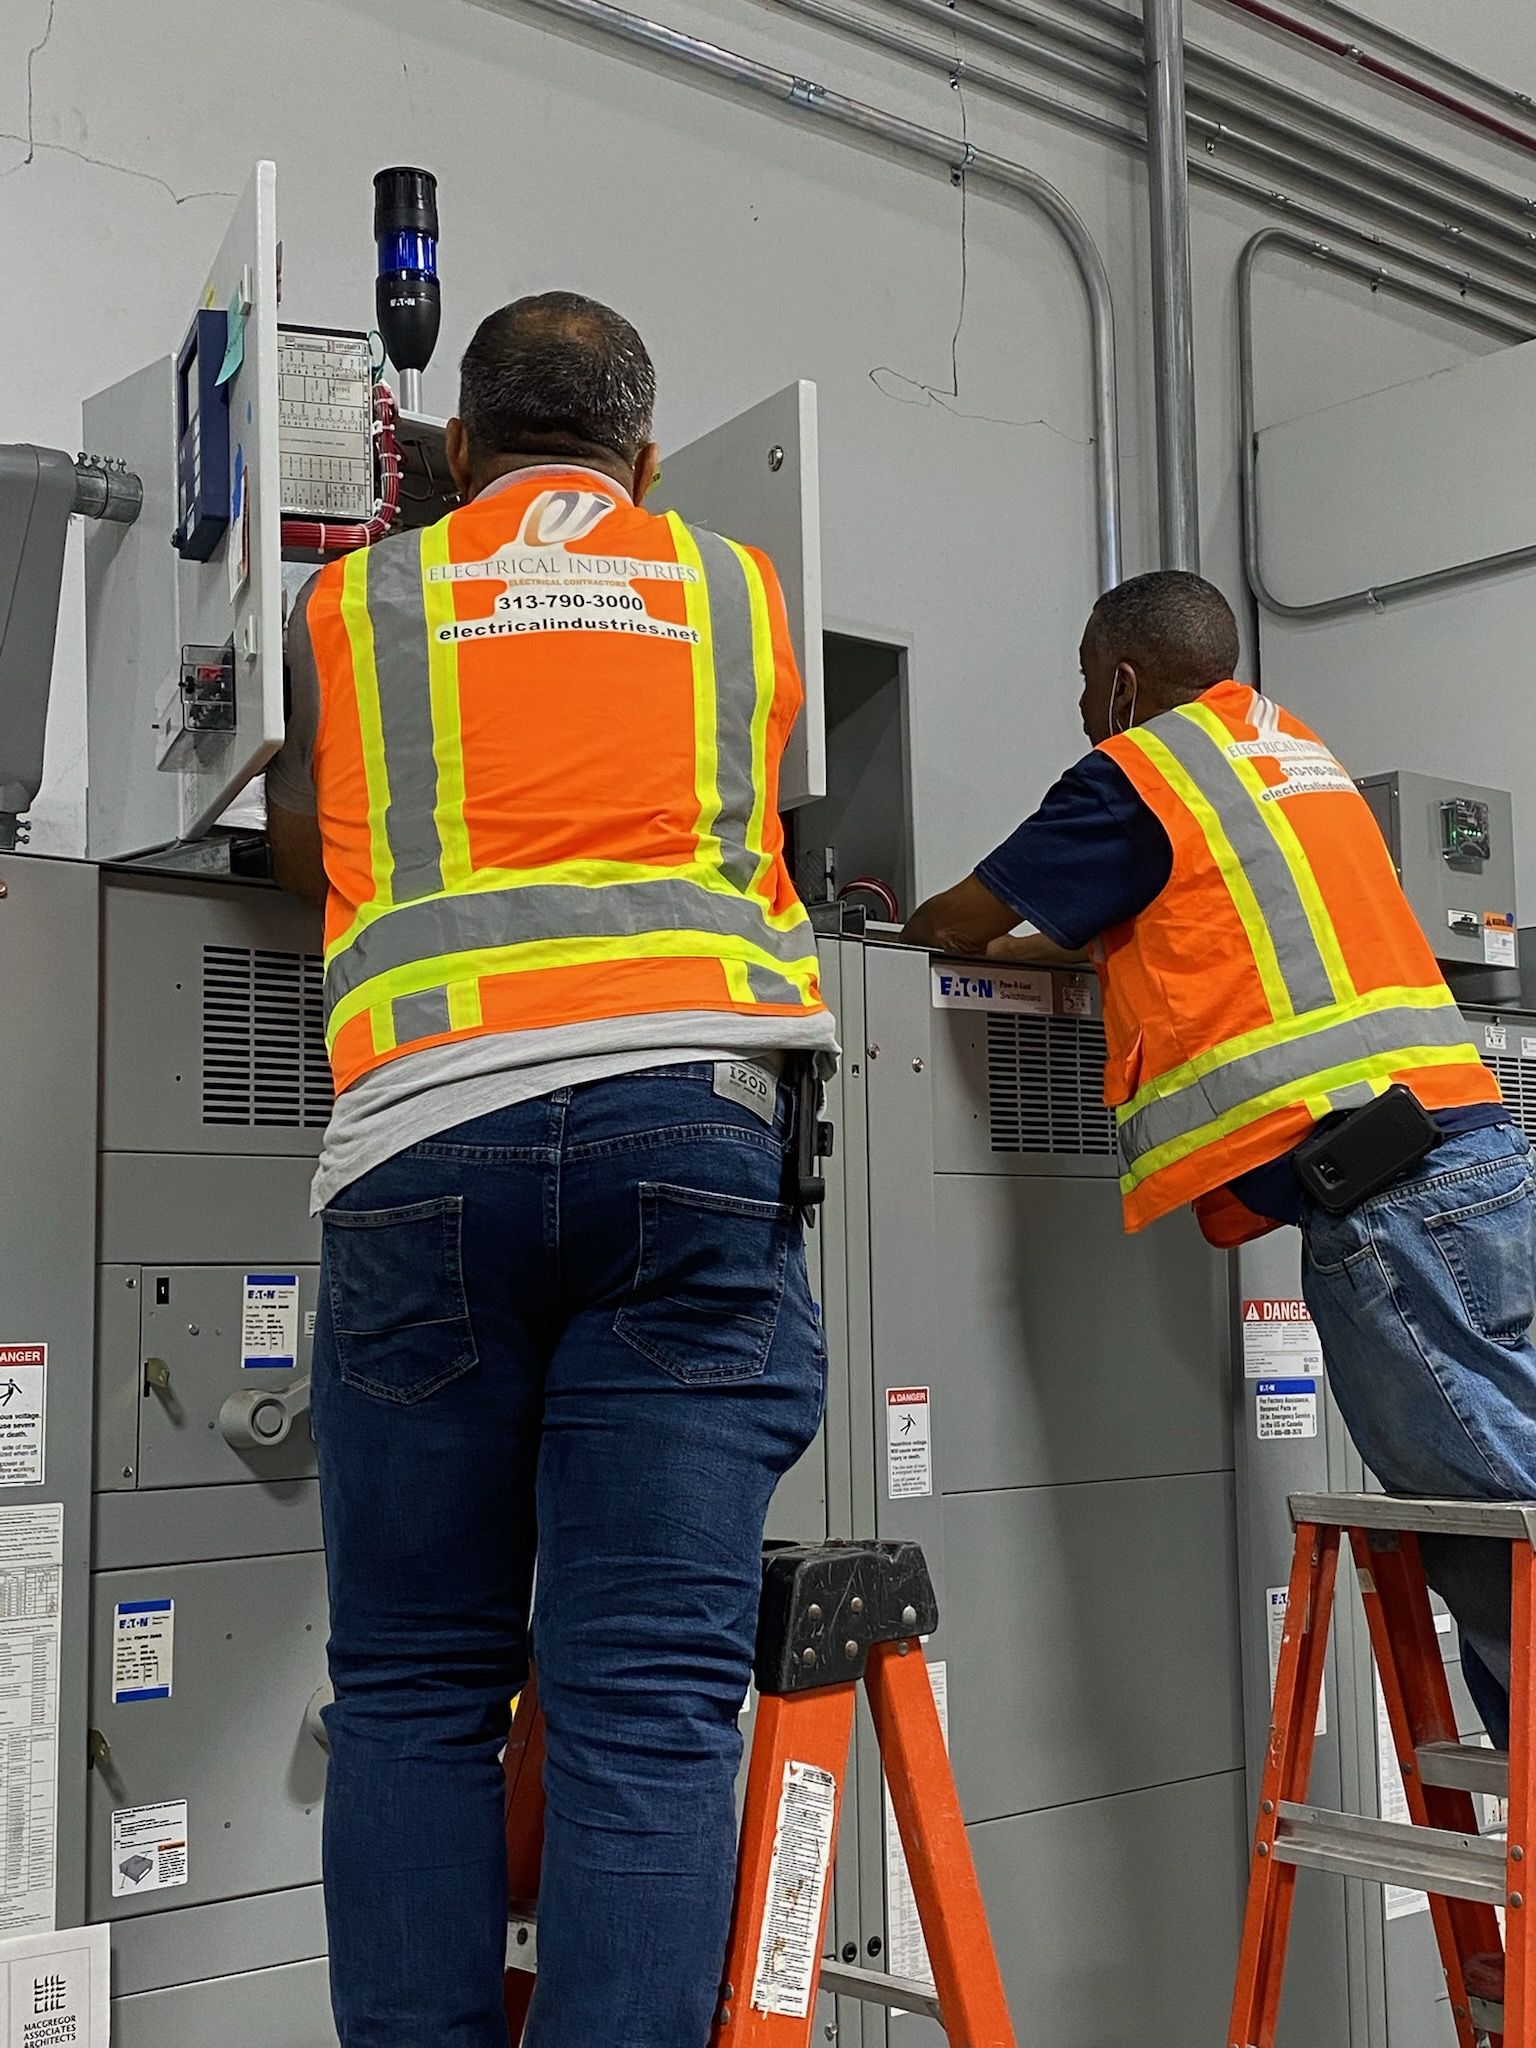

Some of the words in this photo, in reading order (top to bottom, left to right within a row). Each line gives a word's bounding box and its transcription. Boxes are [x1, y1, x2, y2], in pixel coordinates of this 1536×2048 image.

[429, 557, 561, 581] ELECTRICAL
[568, 556, 697, 582] INDUSTRIES
[509, 579, 563, 587] ELECTRICAL
[563, 579, 627, 588] CONTRACTORS
[499, 594, 643, 611] 313-790-3000
[439, 617, 699, 643] electricalindustries.net
[1227, 740, 1297, 758] ELECTRICAL
[730, 1066, 767, 1095] IZOD
[896, 1392, 926, 1402] DANGER
[24, 2015, 76, 2031] MACGREGOR
[24, 2024, 76, 2040] ASSOCIATES
[24, 2033, 76, 2048] ARCHITECTS
